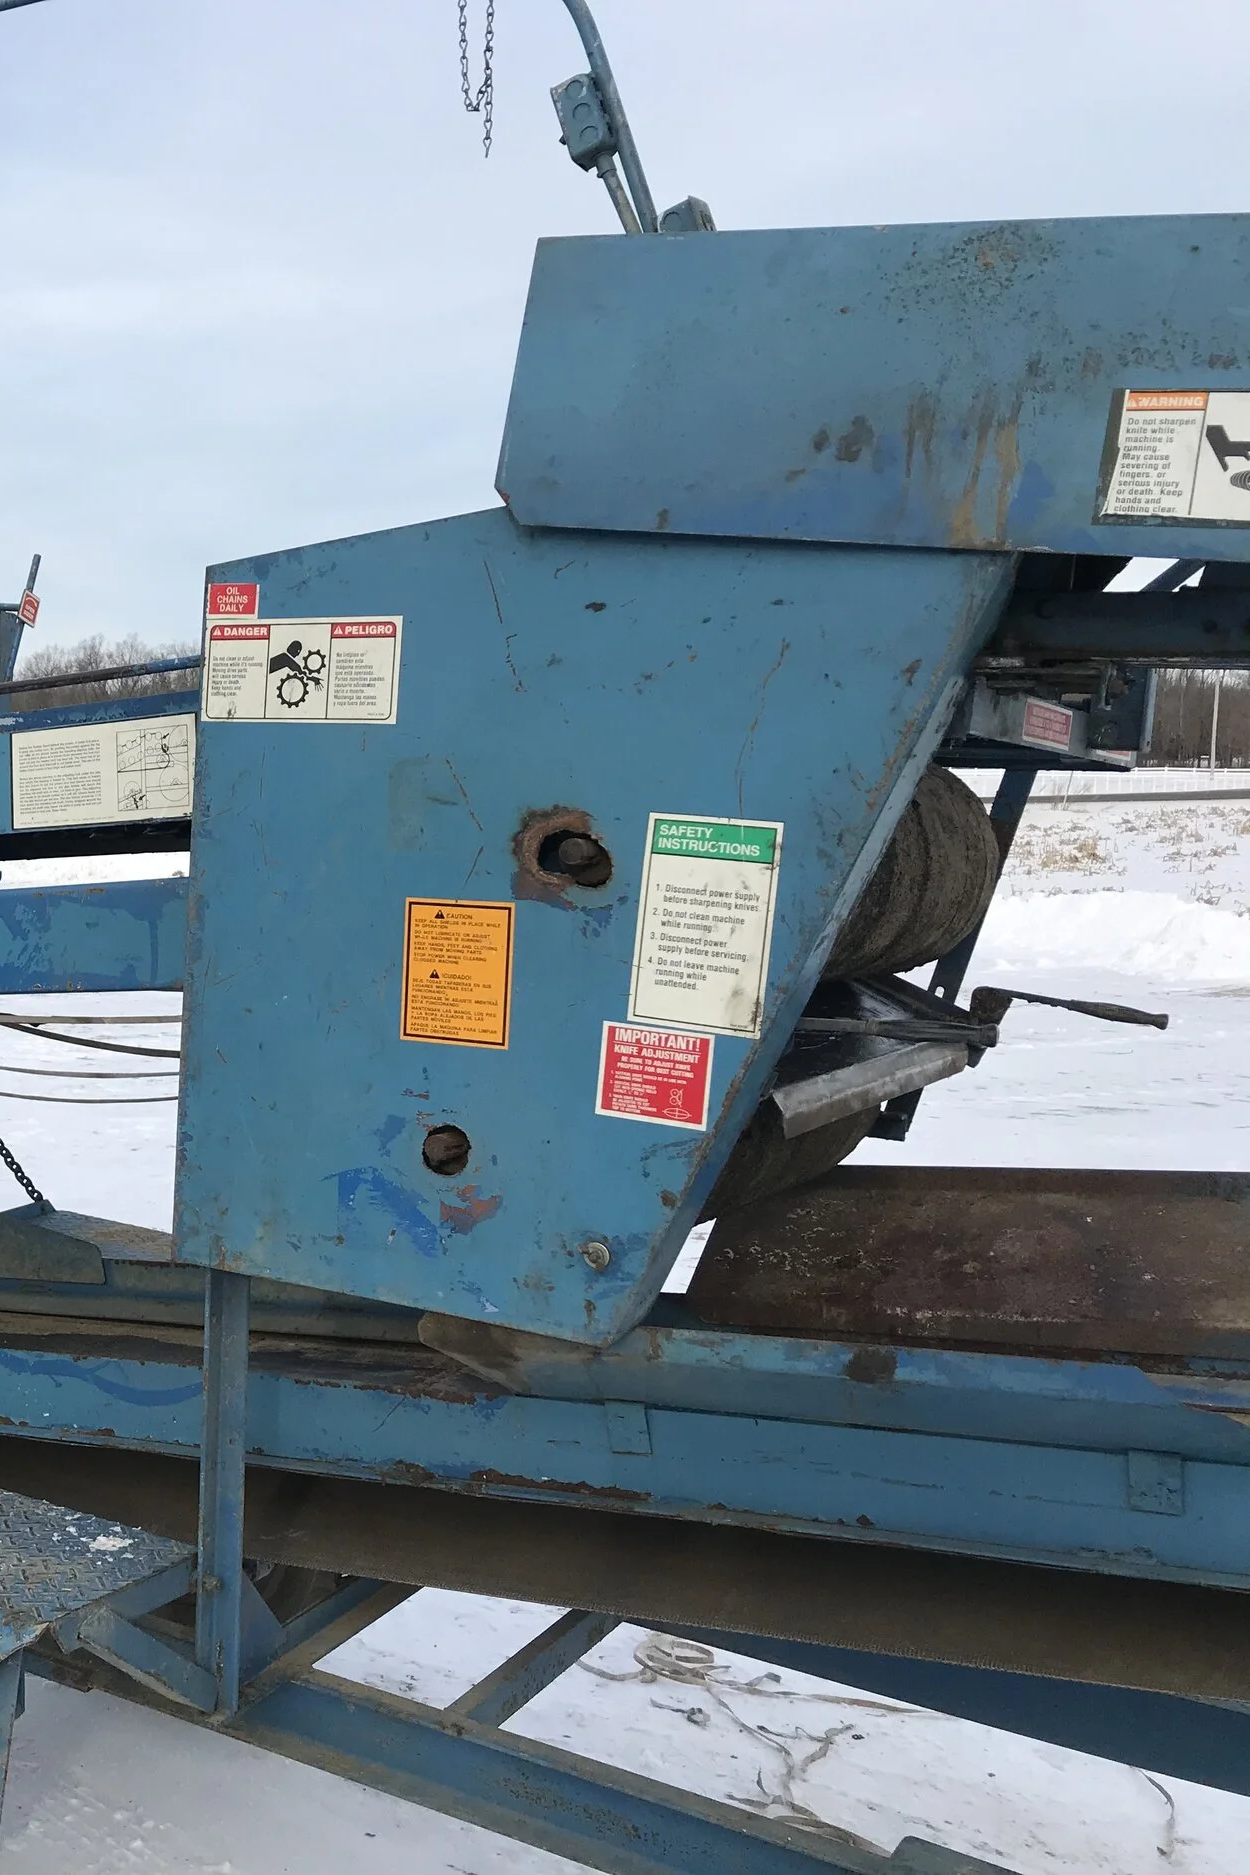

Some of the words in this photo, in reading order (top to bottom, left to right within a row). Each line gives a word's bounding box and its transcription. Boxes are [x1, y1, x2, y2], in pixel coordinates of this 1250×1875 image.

[1138, 397, 1203, 406] WARNING
[1159, 418, 1196, 426] sharpen
[1122, 453, 1141, 461] May
[1121, 462, 1159, 470] severing
[1154, 480, 1179, 488] injury
[1160, 488, 1182, 497] Keep
[226, 587, 240, 595] OIL
[217, 595, 248, 604] CHAINS
[220, 604, 243, 612] DAILY
[224, 627, 267, 636] DANGER
[345, 625, 393, 635] PELIGRO
[660, 824, 713, 838] SAFETY
[658, 837, 760, 856] INSTRUCTIONS
[656, 883, 663, 891] 1.
[665, 884, 707, 896] Disconnect
[709, 889, 733, 898] power
[734, 892, 760, 902] supply
[663, 895, 688, 904] before
[690, 898, 732, 910] sharpening
[652, 907, 659, 915] 2.
[662, 908, 673, 917] Do
[674, 911, 687, 919] not
[689, 912, 710, 921] clean
[712, 914, 745, 925] machine
[661, 920, 681, 928] while
[650, 932, 658, 940] 3.
[660, 933, 702, 945] Disconnect
[704, 939, 727, 948] power
[658, 944, 683, 955] supply
[685, 947, 709, 957] before
[711, 950, 749, 963] servicing.
[647, 956, 654, 964] 4.
[657, 957, 667, 965] Do
[670, 959, 681, 968] not
[684, 960, 704, 970] leave
[707, 965, 740, 975] machine
[656, 968, 684, 979] running
[686, 972, 707, 981] while
[654, 979, 699, 990] unattended.
[615, 1028, 700, 1051] IMPORTANT!
[614, 1044, 639, 1055] KNIFE
[641, 1048, 700, 1063] ADJUSTMENT
[653, 1060, 674, 1068] ADJUST
[617, 1062, 643, 1070] PROPERLY
[671, 1070, 694, 1078] CUTTING
